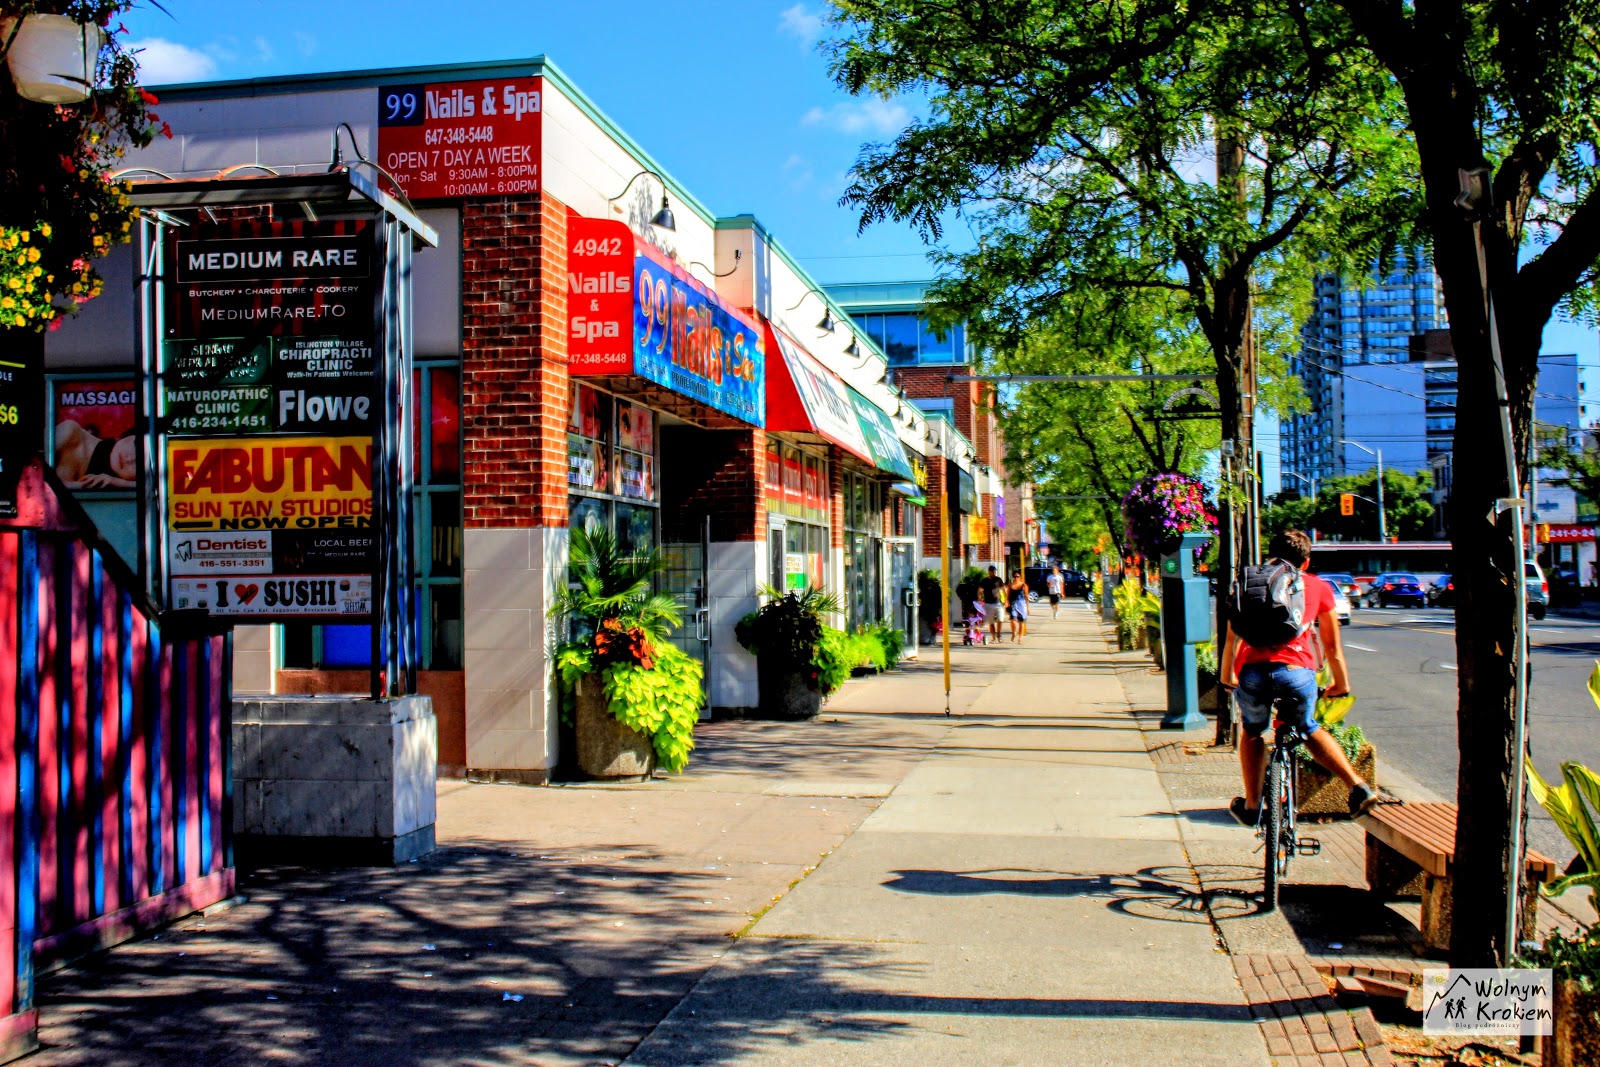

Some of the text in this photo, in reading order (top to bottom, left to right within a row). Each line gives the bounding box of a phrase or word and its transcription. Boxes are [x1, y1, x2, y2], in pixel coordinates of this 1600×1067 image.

[386, 85, 540, 121] 99 Nails & Spa
[425, 126, 493, 146] 647-348-5448
[387, 145, 532, 170] OPEN 7 DAY A WEEK
[390, 172, 410, 184] Mon
[420, 170, 438, 182] Sat
[448, 168, 488, 180] 9:30AM
[498, 164, 537, 178] 8:00PM
[388, 188, 408, 198] Sn
[443, 182, 488, 196] 10:00AM
[498, 180, 537, 193] 6:00PM
[572, 238, 622, 256] 4942
[188, 248, 358, 270] MEDIUM RARE
[567, 272, 630, 294] Nails
[590, 299, 600, 312] &
[571, 316, 619, 343] Spa
[639, 269, 669, 354] 99
[671, 285, 723, 386] Nails
[334, 340, 364, 348] VILLAGE
[306, 360, 353, 370] CLINIC
[314, 370, 340, 378] Patients
[168, 388, 269, 402] NATUROPATHIC
[195, 402, 240, 414] CLINIC
[279, 390, 370, 426] Flowe
[172, 416, 266, 428] 416-234-1451
[173, 445, 373, 494] FABUTAN
[174, 498, 373, 518] SUN TAN STUDIOS
[220, 516, 373, 530] NOW OPEN
[197, 539, 267, 550] Dentist
[314, 539, 346, 548] LOCAL
[199, 560, 265, 568] 416-551-3351
[216, 580, 336, 608] I SUSHI
